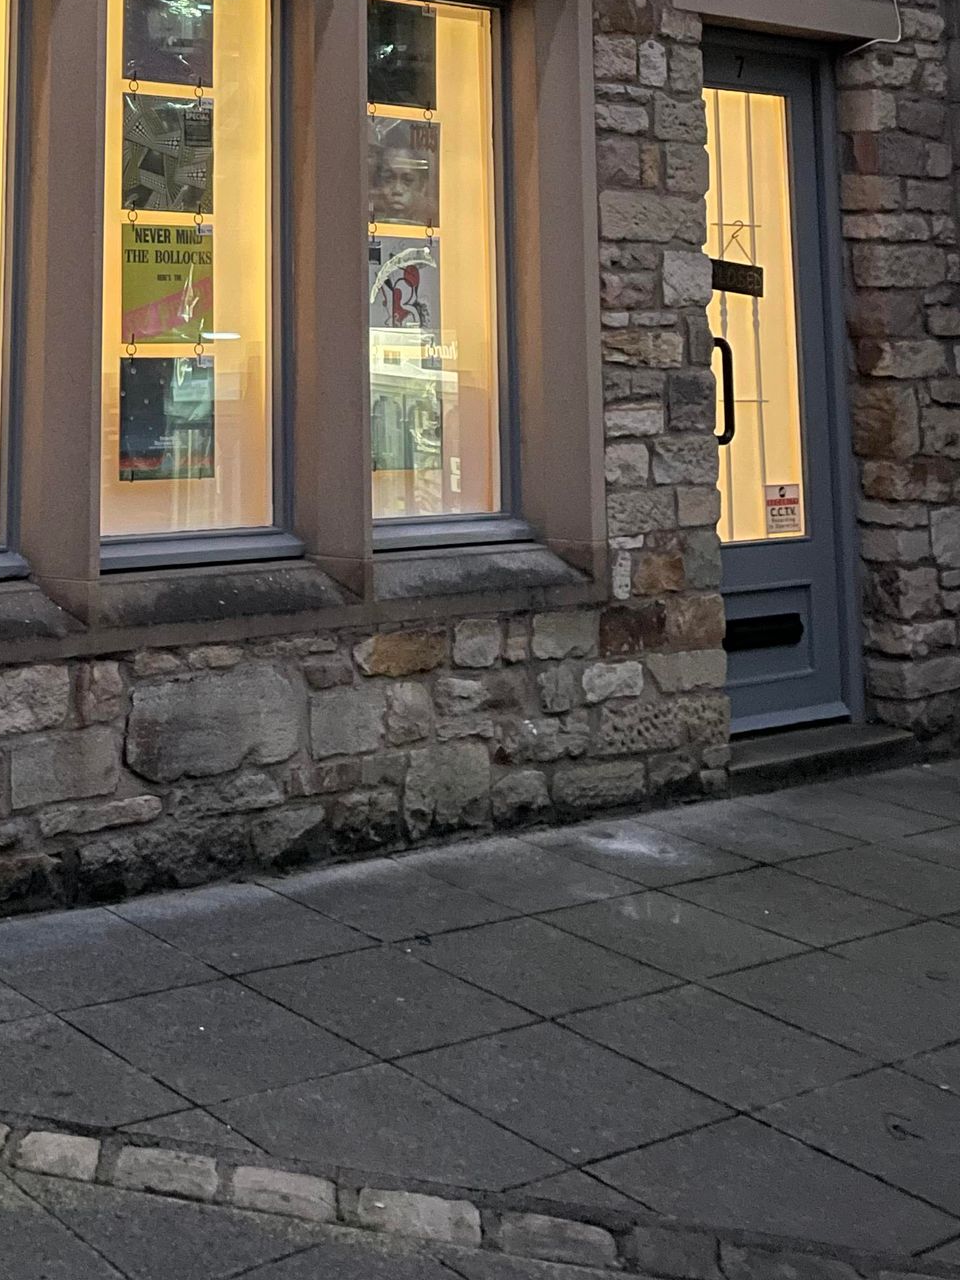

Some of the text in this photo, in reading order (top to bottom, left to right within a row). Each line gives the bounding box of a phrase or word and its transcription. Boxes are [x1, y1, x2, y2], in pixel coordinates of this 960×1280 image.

[135, 228, 171, 244] NEVER
[125, 249, 212, 265] THE BOLLOCKS
